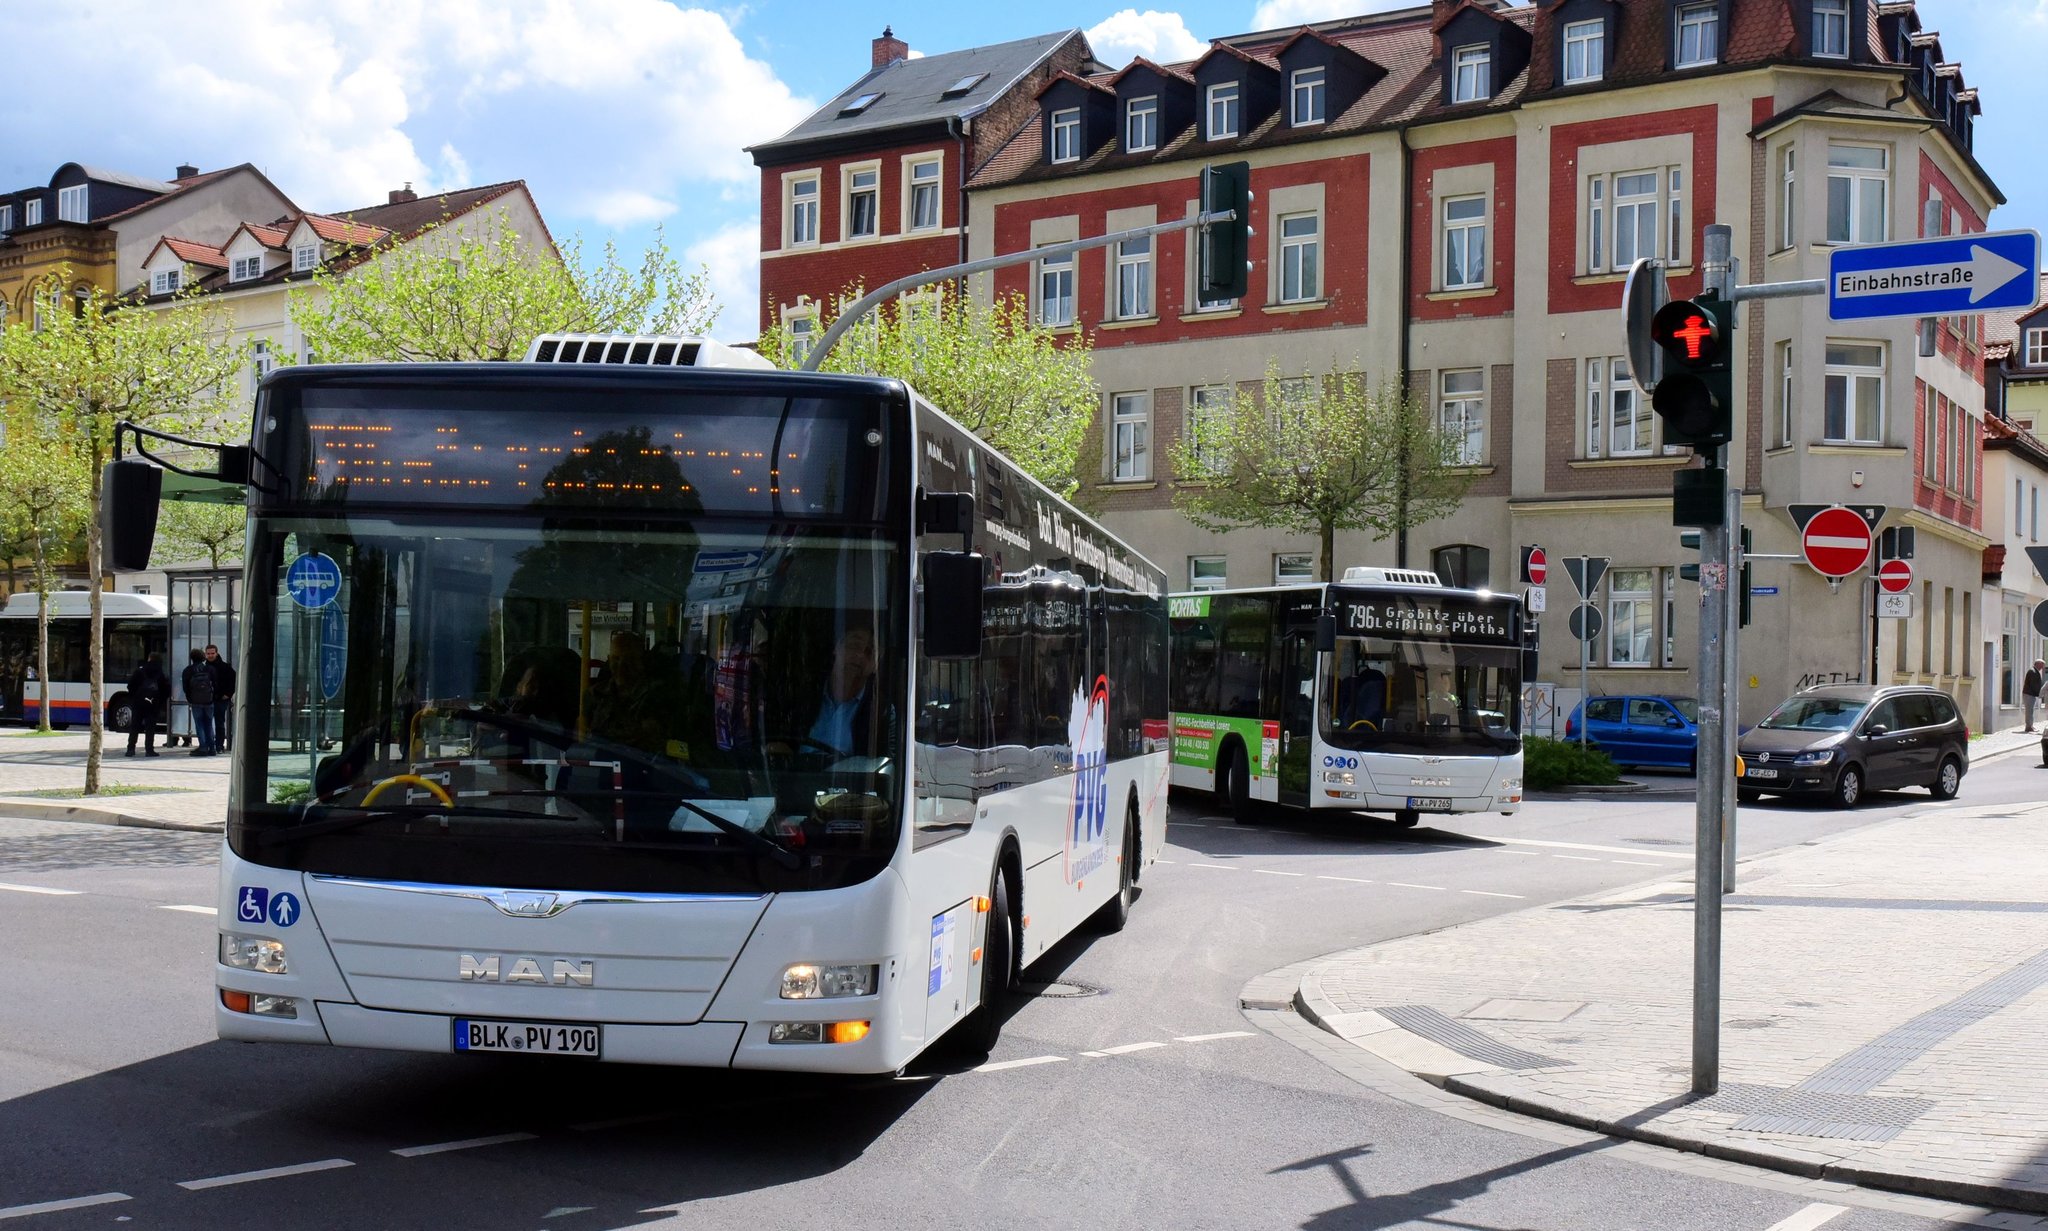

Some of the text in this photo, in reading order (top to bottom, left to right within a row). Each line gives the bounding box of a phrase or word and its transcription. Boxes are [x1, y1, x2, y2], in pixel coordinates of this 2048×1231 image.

[1840, 267, 1974, 293] Einbahnstraße
[926, 440, 943, 463] MAN
[1036, 500, 1053, 545] Bad
[1169, 598, 1201, 618] PORTAS
[1348, 604, 1494, 629] 796 Gröbitz über
[1375, 616, 1505, 636] Leißling-Plotha
[1410, 776, 1451, 786] MAN
[1073, 748, 1107, 850] PVG
[1411, 798, 1450, 808] BLK PV 265
[460, 954, 594, 986] MAN
[469, 1024, 509, 1048] BLK
[525, 1026, 552, 1050] PV
[557, 1028, 596, 1052] 190
